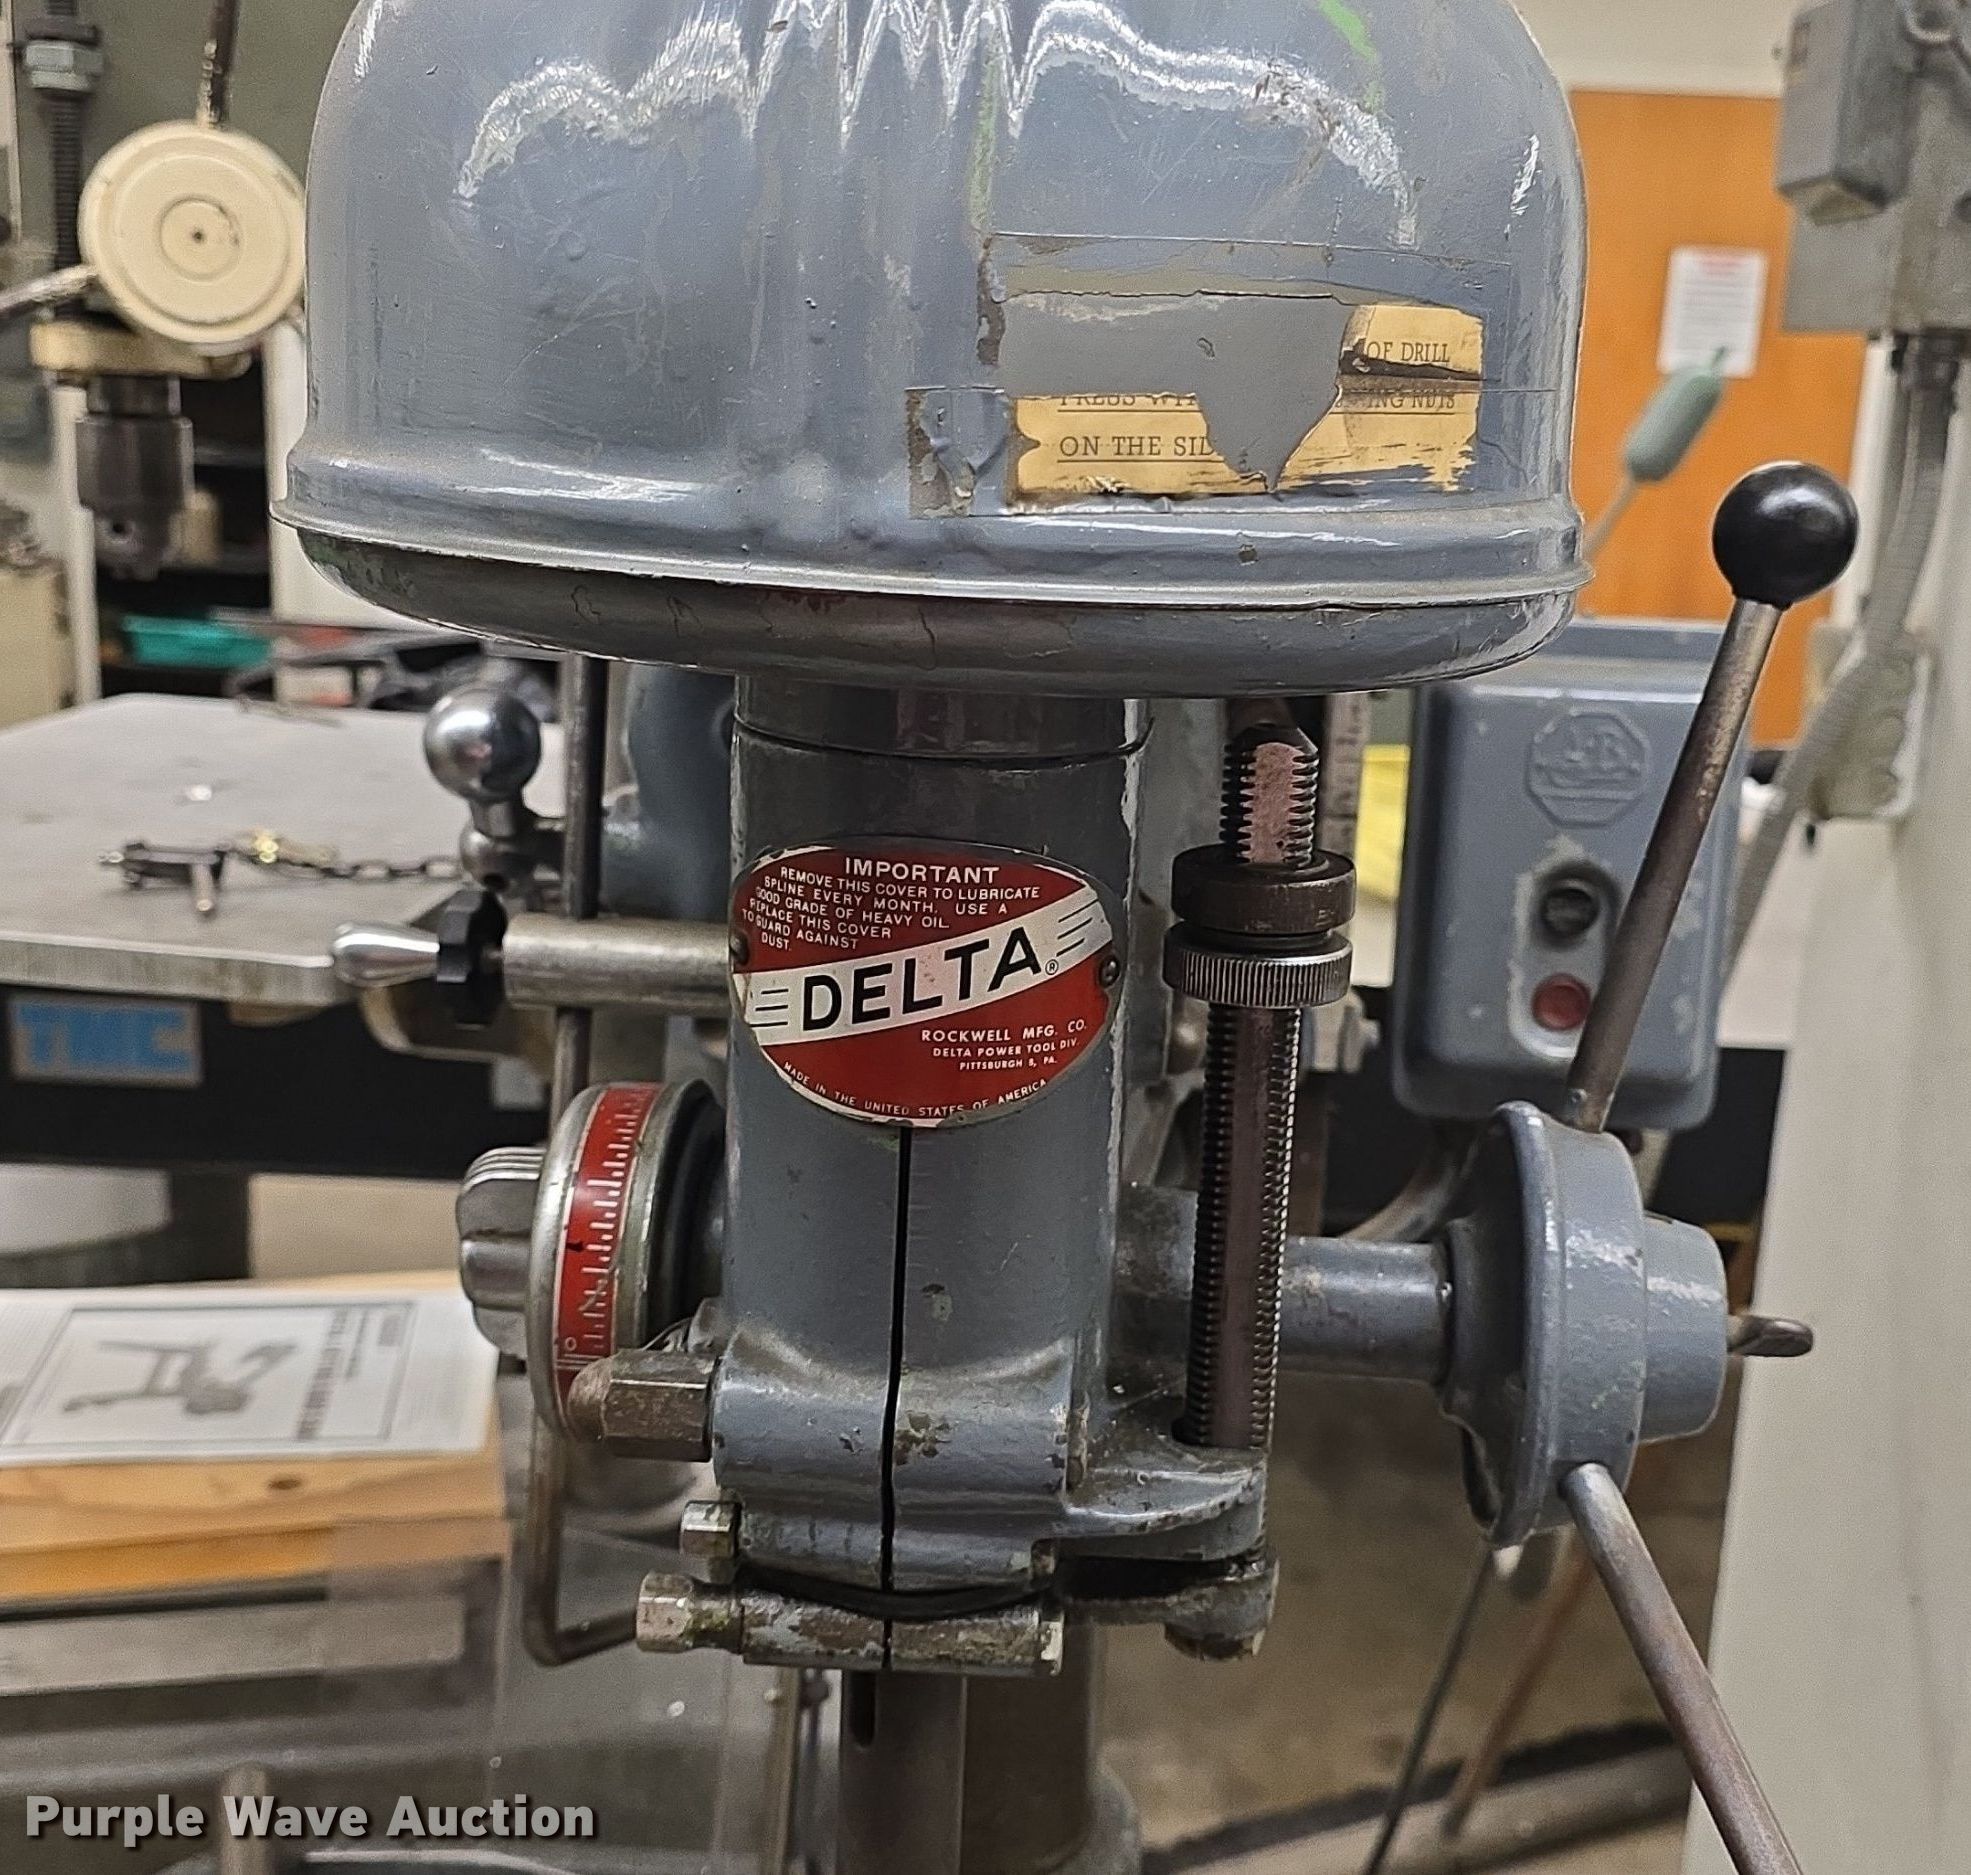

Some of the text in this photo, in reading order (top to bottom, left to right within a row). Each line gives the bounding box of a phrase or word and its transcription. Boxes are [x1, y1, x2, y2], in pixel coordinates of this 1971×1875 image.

[1367, 341, 1451, 362] OF DRILL
[1060, 436, 1101, 457] ON
[1111, 436, 1162, 456] THE
[780, 867, 1041, 901] REMOVE THIS COVER TO LUBRICATE
[845, 857, 1000, 884] IMPORTANT
[756, 886, 780, 904] GOOD
[785, 897, 828, 916] GRADE
[835, 907, 855, 919] OF
[862, 911, 913, 927] HEAVY
[764, 876, 1008, 915] SPLINE EVERY MONTH. USE A
[742, 908, 859, 949] TO GUARD AGAINST
[749, 898, 892, 939] REPLACE THIS COVER
[803, 926, 1042, 1031] DELTA
[921, 1018, 1087, 1042] ROCKWELL MFG. CO.
[933, 1047, 972, 1057] DELTA
[977, 1046, 1022, 1057] POWER
[1027, 1043, 1056, 1054] TOOL
[959, 1059, 1023, 1071] PITTSBURGH
[783, 1061, 1047, 1117] MADE IN THE UNITED STATES OF AMERICA
